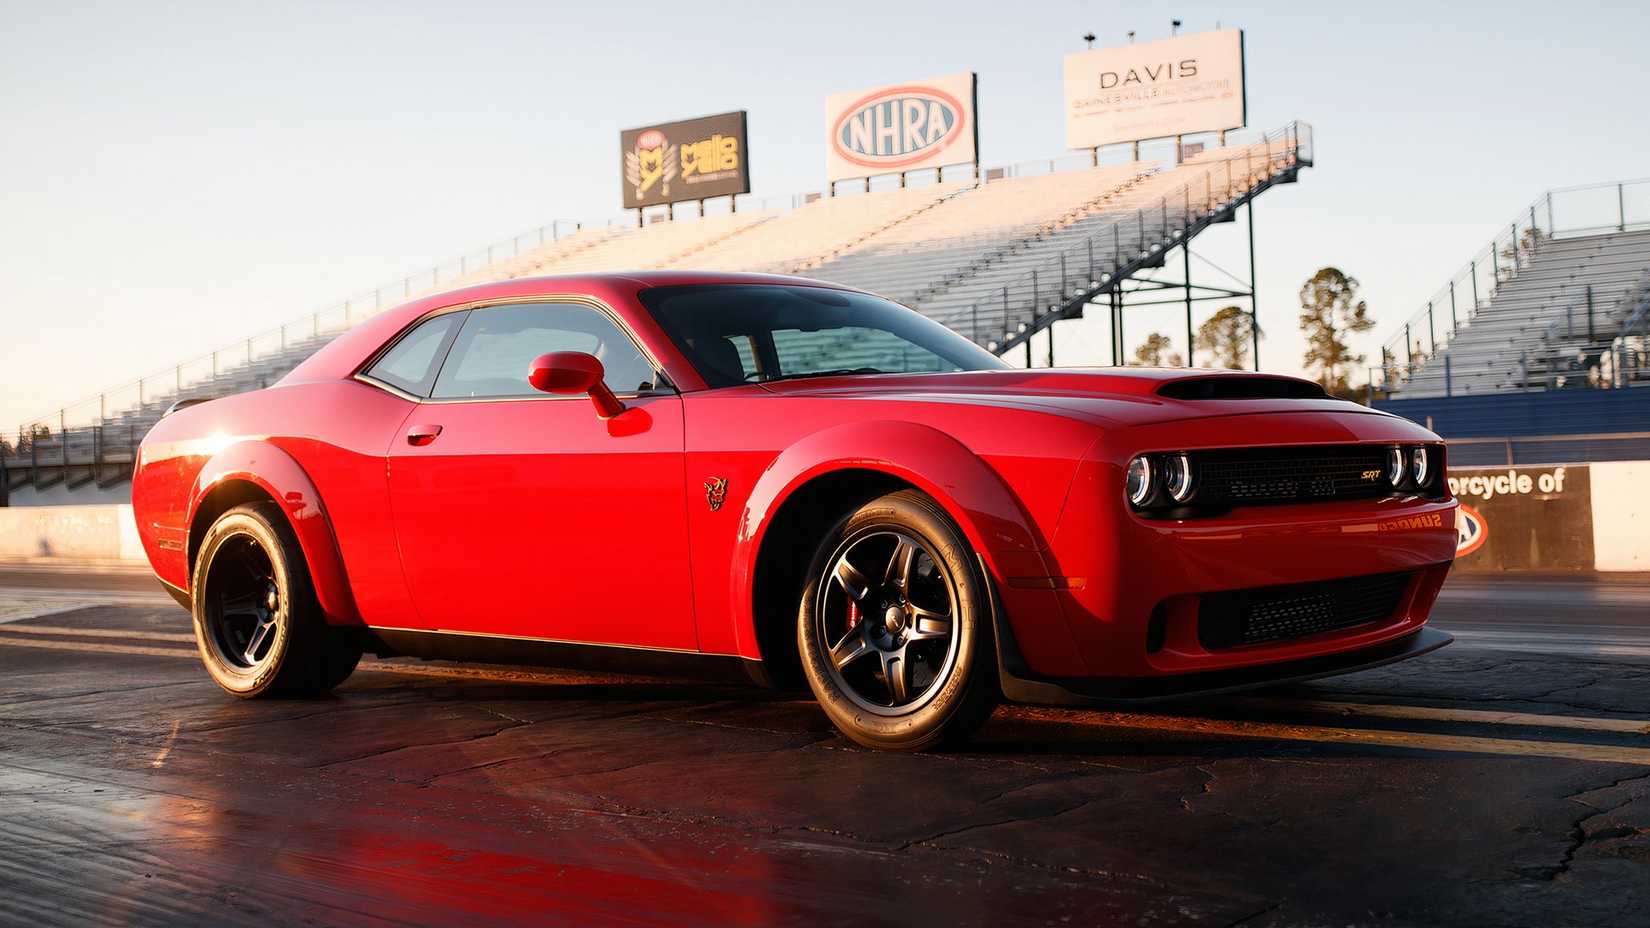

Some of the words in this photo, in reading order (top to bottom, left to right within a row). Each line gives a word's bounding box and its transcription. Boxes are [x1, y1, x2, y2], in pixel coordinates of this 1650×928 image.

[1099, 59, 1198, 89] DAVIS
[849, 97, 948, 156] NHRA
[1360, 469, 1381, 481] SRT
[1448, 469, 1534, 500] orcycle
[1538, 467, 1566, 493] of
